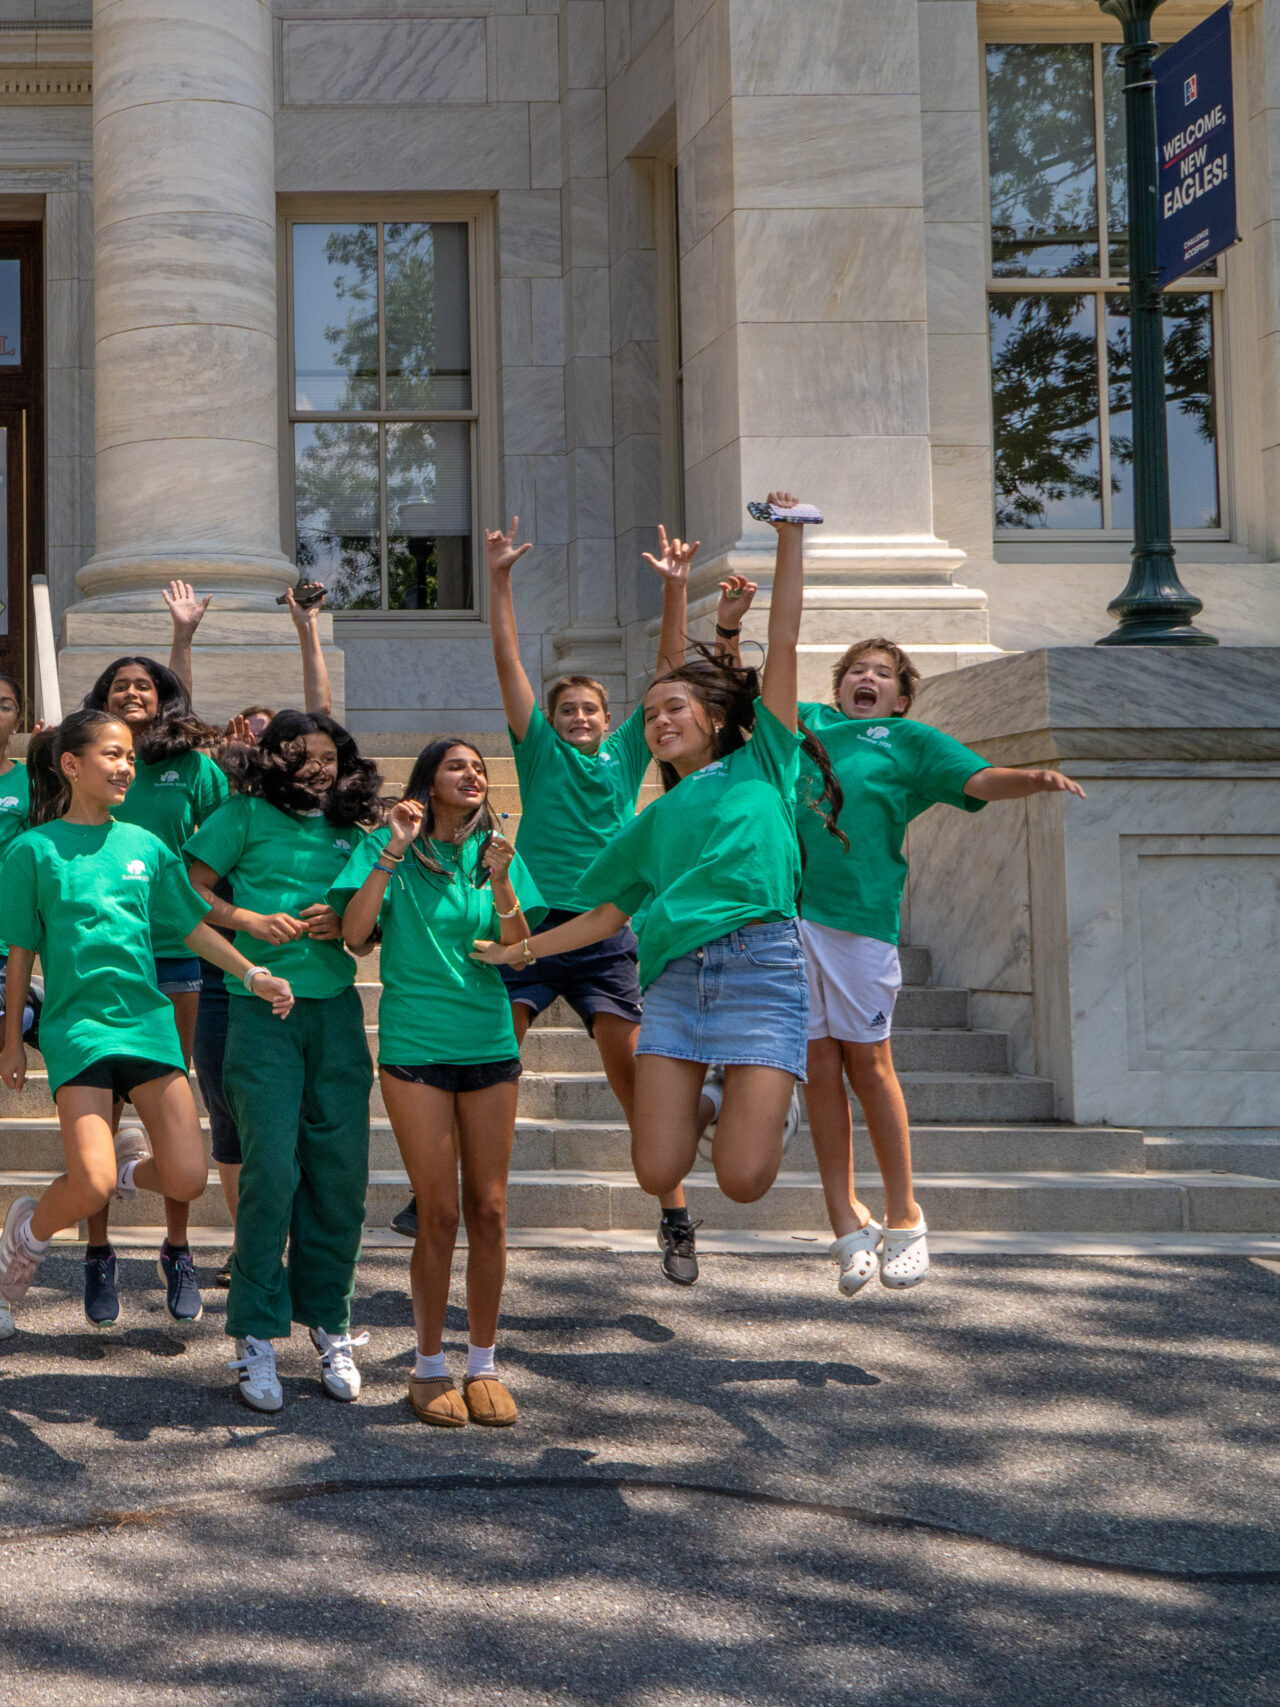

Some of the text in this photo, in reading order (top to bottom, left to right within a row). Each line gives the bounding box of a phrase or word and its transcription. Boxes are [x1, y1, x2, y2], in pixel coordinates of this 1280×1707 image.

[1163, 104, 1226, 162] WELCOME,
[1181, 144, 1207, 179] NEW
[1164, 153, 1228, 219] EAGLES!
